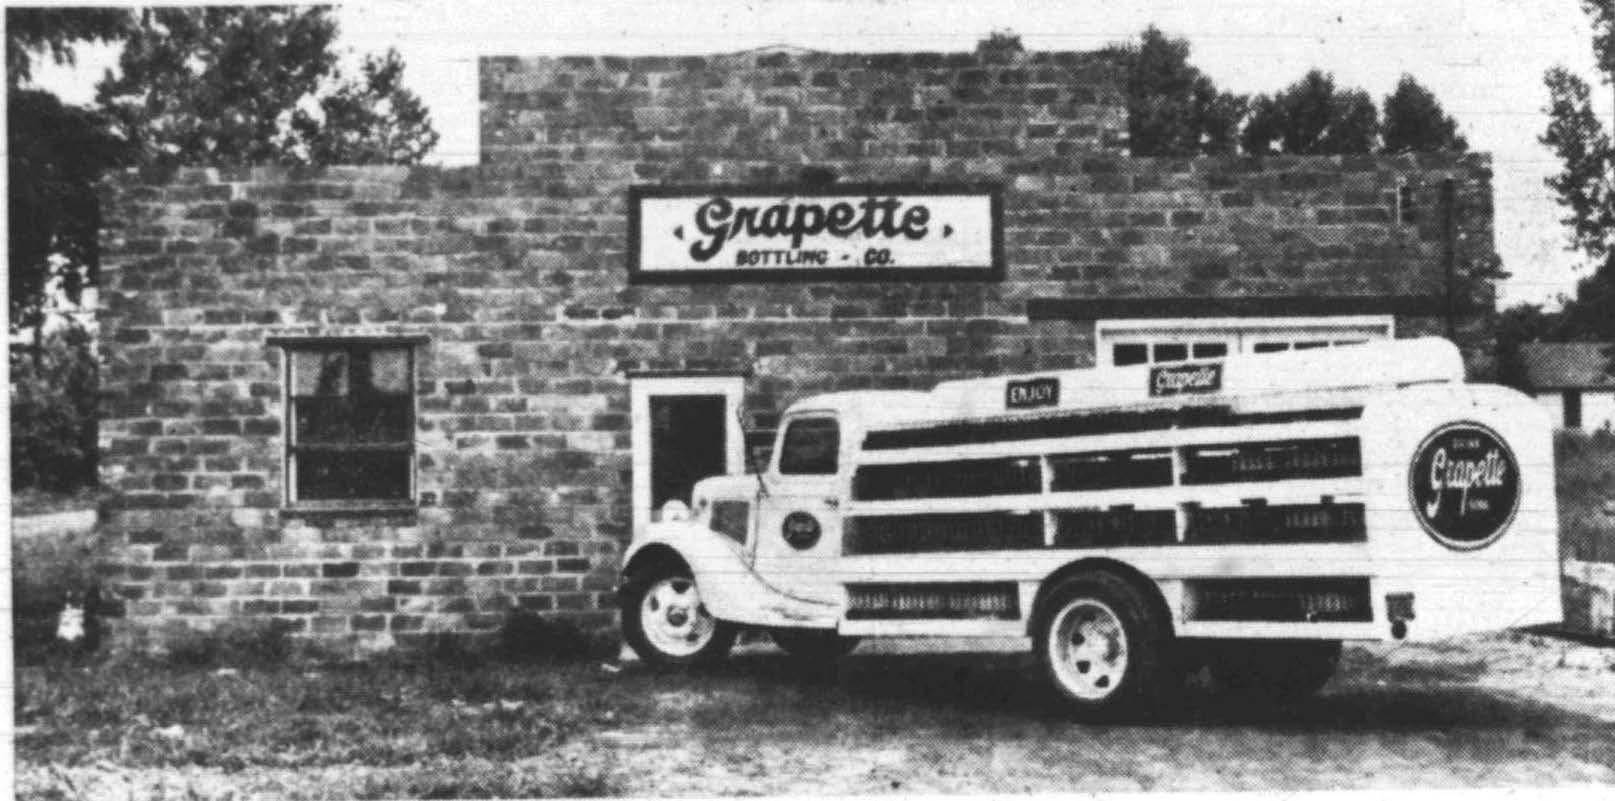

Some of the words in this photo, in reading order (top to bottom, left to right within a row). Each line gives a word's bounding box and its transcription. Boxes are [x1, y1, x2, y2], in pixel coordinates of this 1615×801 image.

[689, 197, 930, 262] Grapette
[736, 248, 828, 266] BOTTLING
[1010, 384, 1053, 404] ENJOY
[1426, 447, 1507, 518] Grapette
